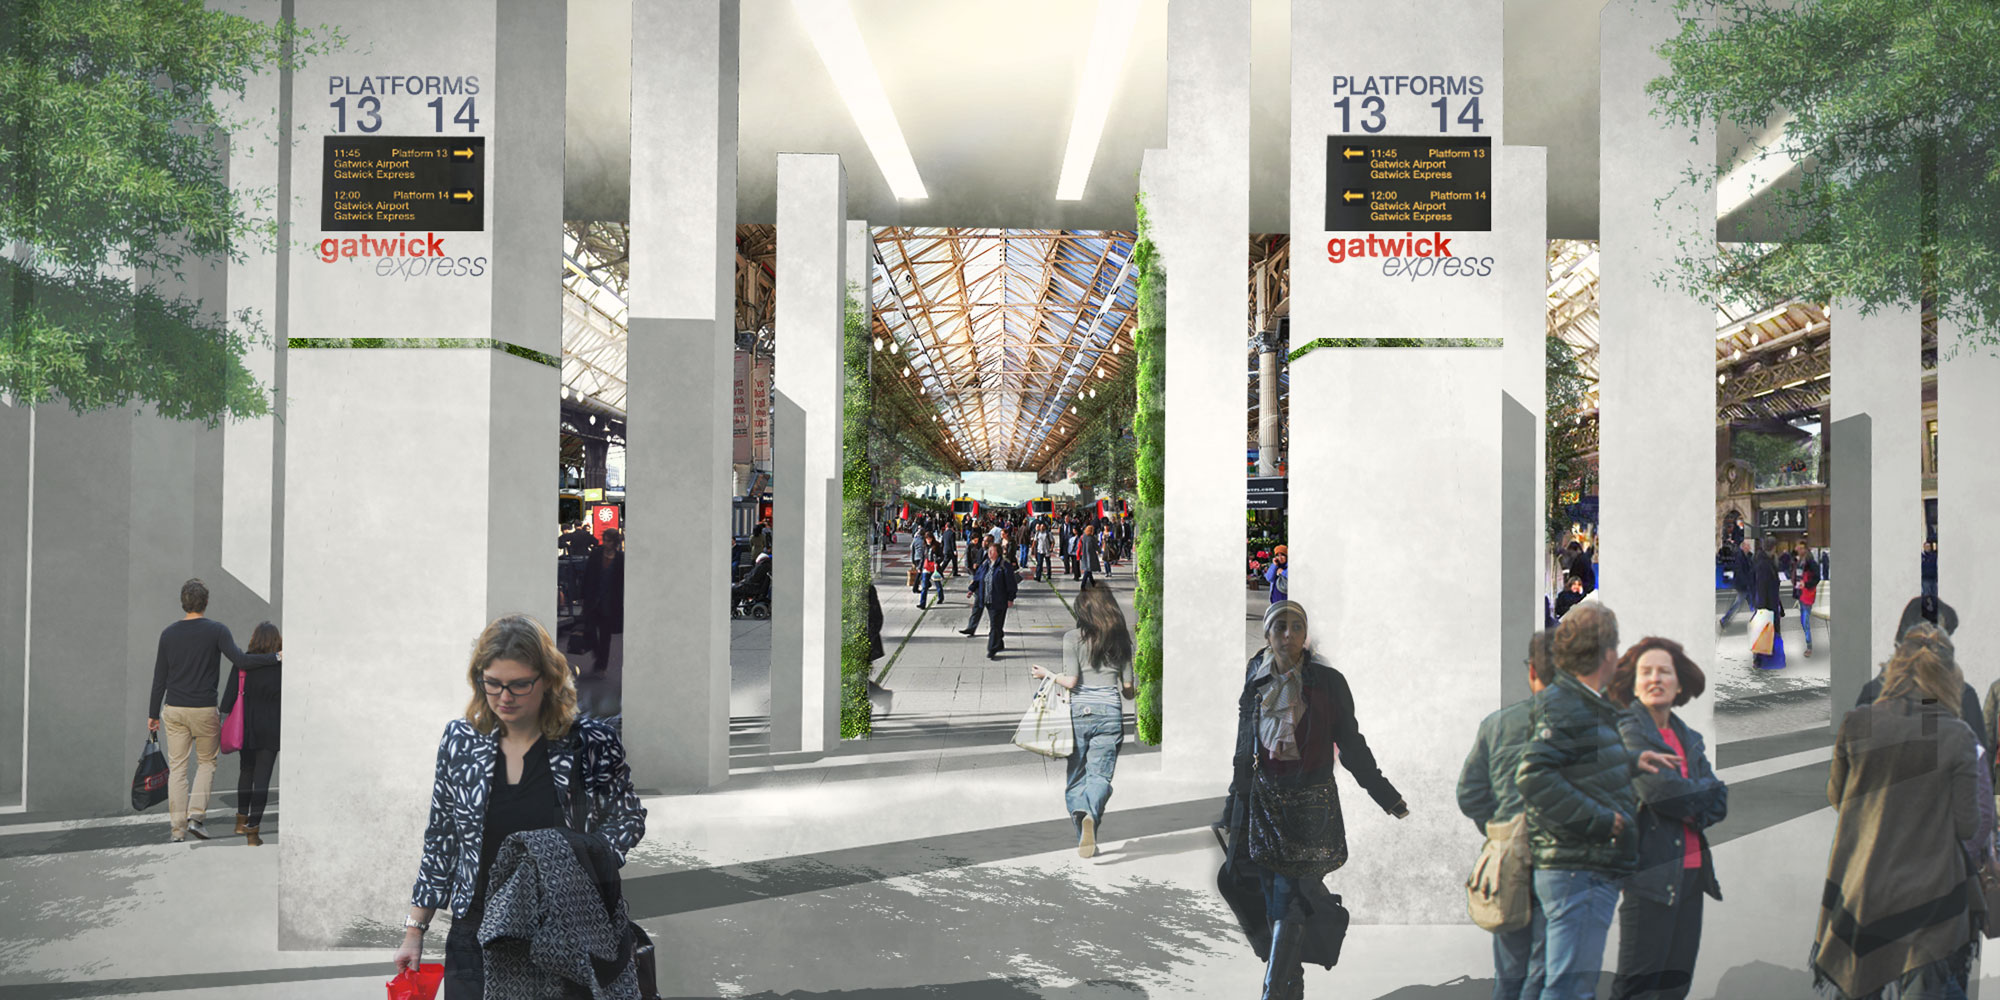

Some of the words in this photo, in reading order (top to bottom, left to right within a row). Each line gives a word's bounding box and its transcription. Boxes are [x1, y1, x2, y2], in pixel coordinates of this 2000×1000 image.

[329, 76, 479, 95] PLATFORMS
[1333, 76, 1484, 95] PLATFORMS
[330, 96, 382, 133] 13
[428, 97, 479, 132] 14
[1334, 96, 1386, 133] 13
[1431, 97, 1483, 132] 14
[334, 149, 360, 158] 11:45
[392, 149, 433, 158] Platform
[436, 149, 448, 158] 13
[1371, 149, 1397, 158] 11:45
[1429, 149, 1470, 158] Platform
[1473, 149, 1485, 158] 13
[334, 160, 373, 169] Gatwick
[376, 160, 408, 169] Airport
[1371, 160, 1410, 168] Gatwick
[1413, 160, 1446, 169] Airport
[334, 170, 373, 178] Gatwick
[376, 170, 415, 179] Express
[1371, 170, 1410, 179] Gatwick
[1413, 170, 1452, 180] Express
[334, 191, 360, 200] 12:00
[393, 191, 434, 200] Platform
[438, 191, 449, 200] 14
[1371, 191, 1397, 200] 12:00
[1430, 191, 1472, 200] Platform
[1475, 191, 1486, 200] 14
[334, 201, 373, 210] Gatwick
[376, 202, 408, 211] Airport
[1371, 201, 1410, 210] Gatwick
[1412, 202, 1446, 211] Airport
[334, 212, 373, 220] Gatwick
[376, 212, 415, 222] Express
[1371, 212, 1410, 221] Gatwick
[1413, 212, 1452, 222] Express
[321, 232, 445, 263] gatwick
[1328, 232, 1452, 263] gatwick
[376, 257, 487, 281] express
[1383, 257, 1494, 281] express
